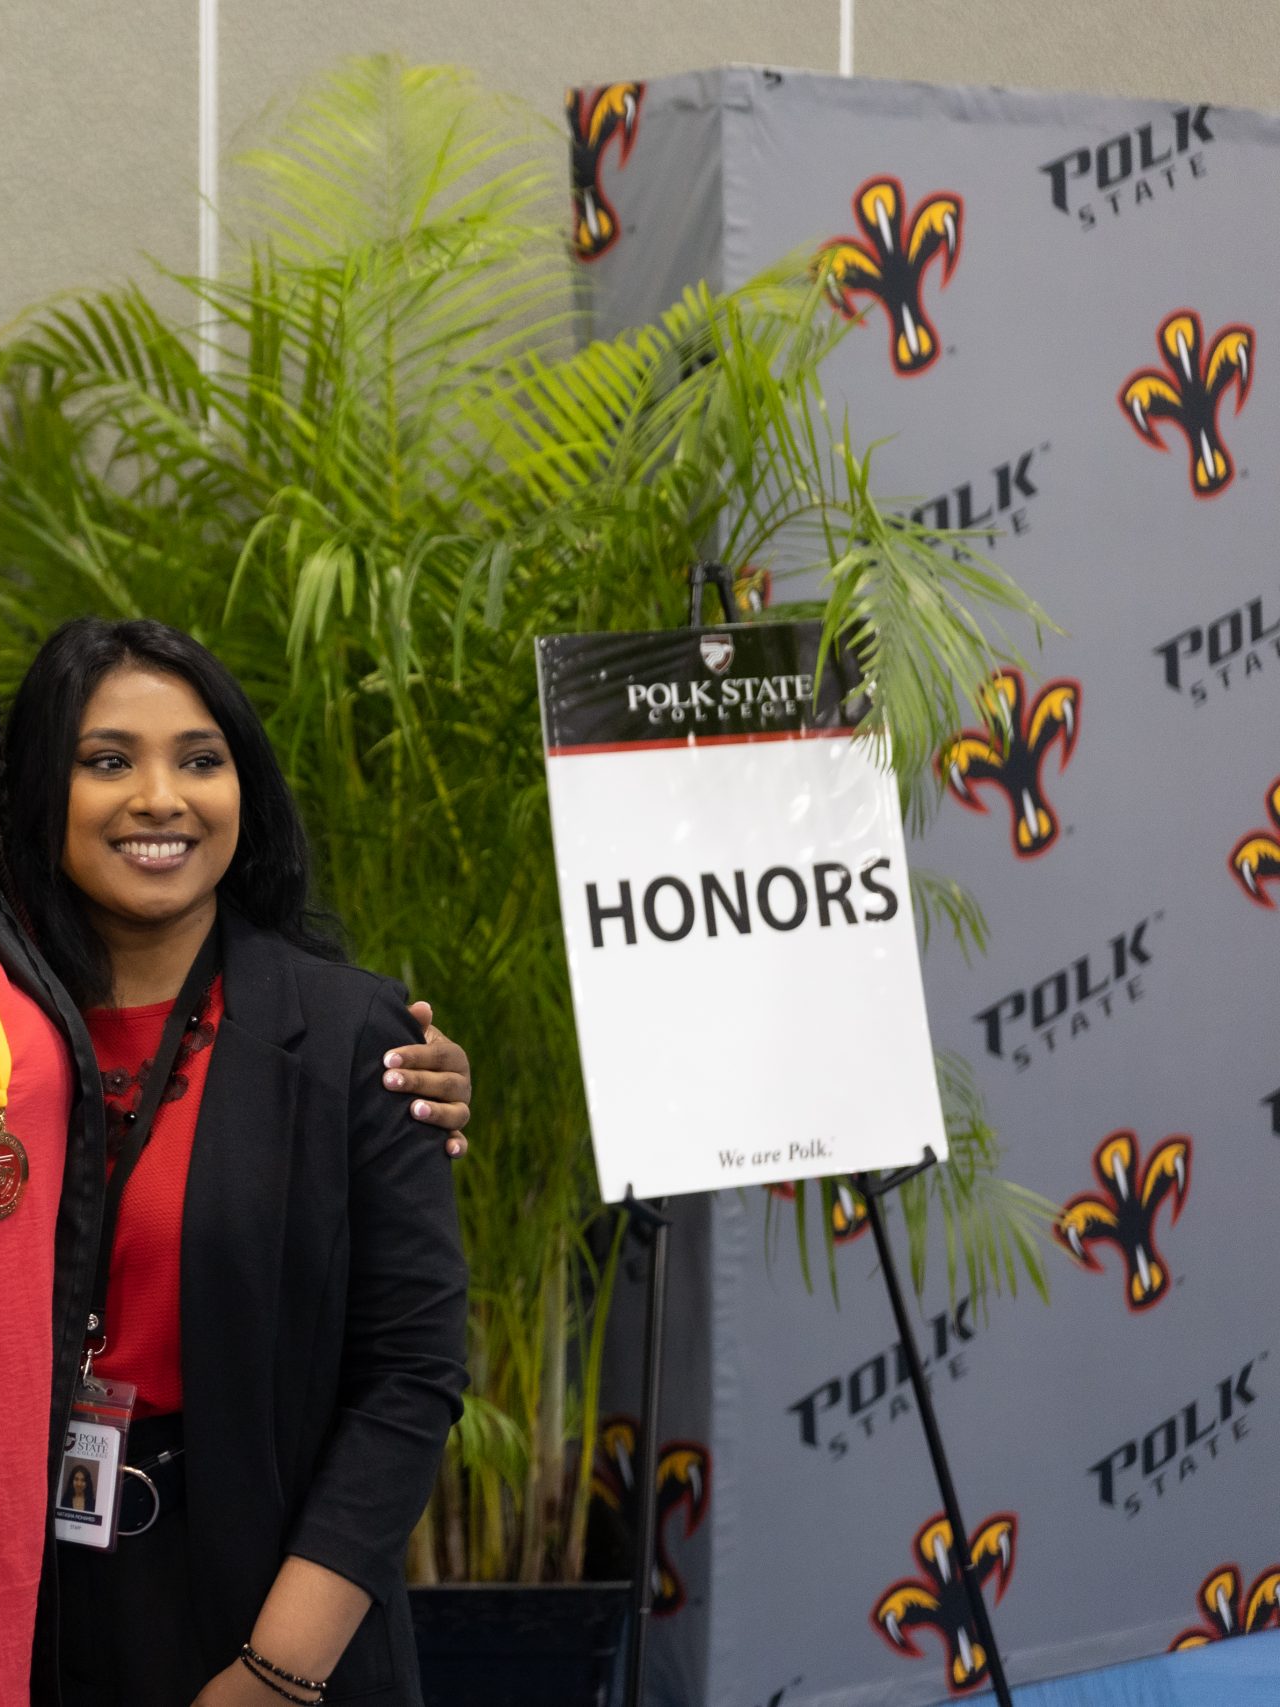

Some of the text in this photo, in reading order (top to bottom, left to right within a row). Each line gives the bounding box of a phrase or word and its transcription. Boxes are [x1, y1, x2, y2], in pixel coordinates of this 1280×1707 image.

[1039, 103, 1215, 215] POLK
[1077, 151, 1207, 232] STATE
[1152, 594, 1280, 694] POL
[627, 674, 814, 712] POLK STATE
[648, 699, 798, 726] COLLEGE
[585, 857, 898, 948] HONORS
[973, 917, 1152, 1060] POLK
[1012, 973, 1145, 1073] STATE
[718, 1148, 745, 1169] We
[752, 1150, 781, 1166] are
[77, 1441, 108, 1454] STATE
[79, 1433, 109, 1446] POLK
[828, 1352, 969, 1463] STAE
[1087, 1358, 1257, 1509] POLK
[1124, 1415, 1252, 1519] STATE
